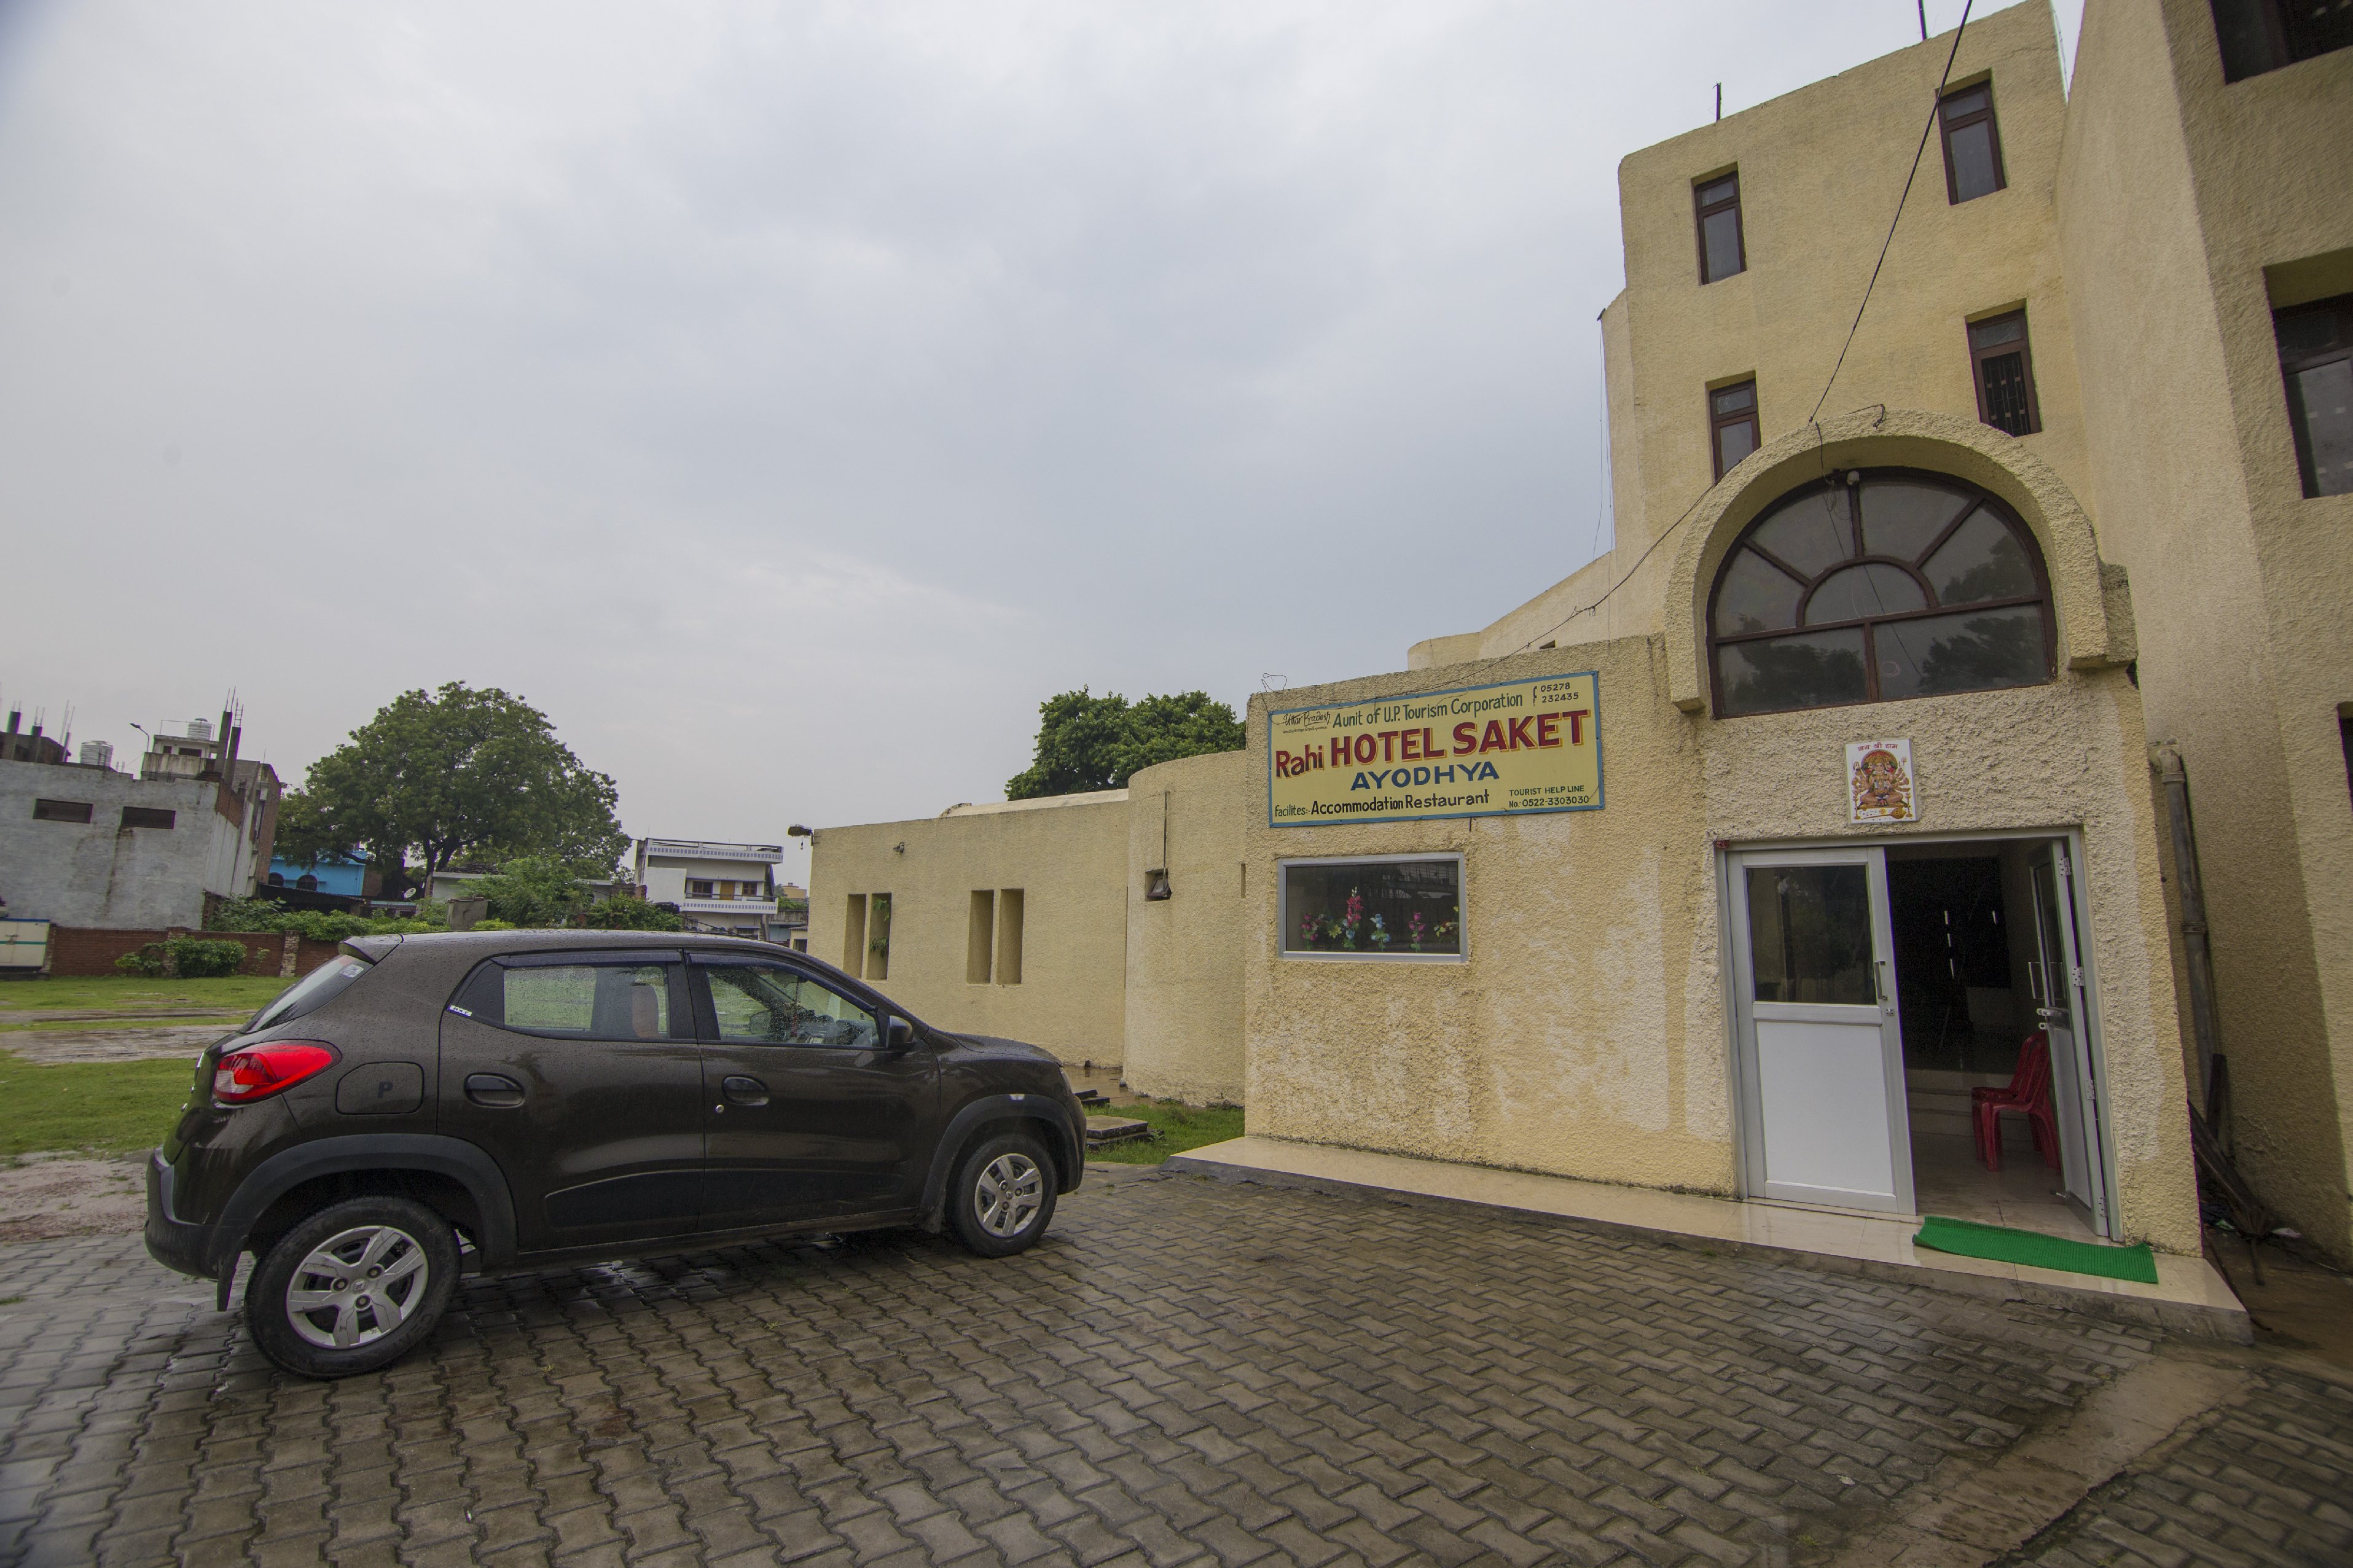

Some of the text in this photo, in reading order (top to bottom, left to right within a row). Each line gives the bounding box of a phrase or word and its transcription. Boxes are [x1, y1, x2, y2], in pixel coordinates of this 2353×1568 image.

[1540, 682, 1570, 692] 05278
[1542, 692, 1580, 703] 232435
[1283, 711, 1332, 727] Uttar Pradesh
[1366, 708, 1381, 724] of
[1384, 706, 1401, 722] U.P.
[1403, 704, 1447, 720] Tourism
[1451, 693, 1523, 718] Corporation
[1275, 709, 1591, 779] Rahi HOTEL SAKET
[1350, 761, 1500, 791] AYODHYA
[1310, 796, 1404, 815] Accommodation
[1405, 789, 1490, 808] Restaurant
[1509, 787, 1542, 797] TOURIST
